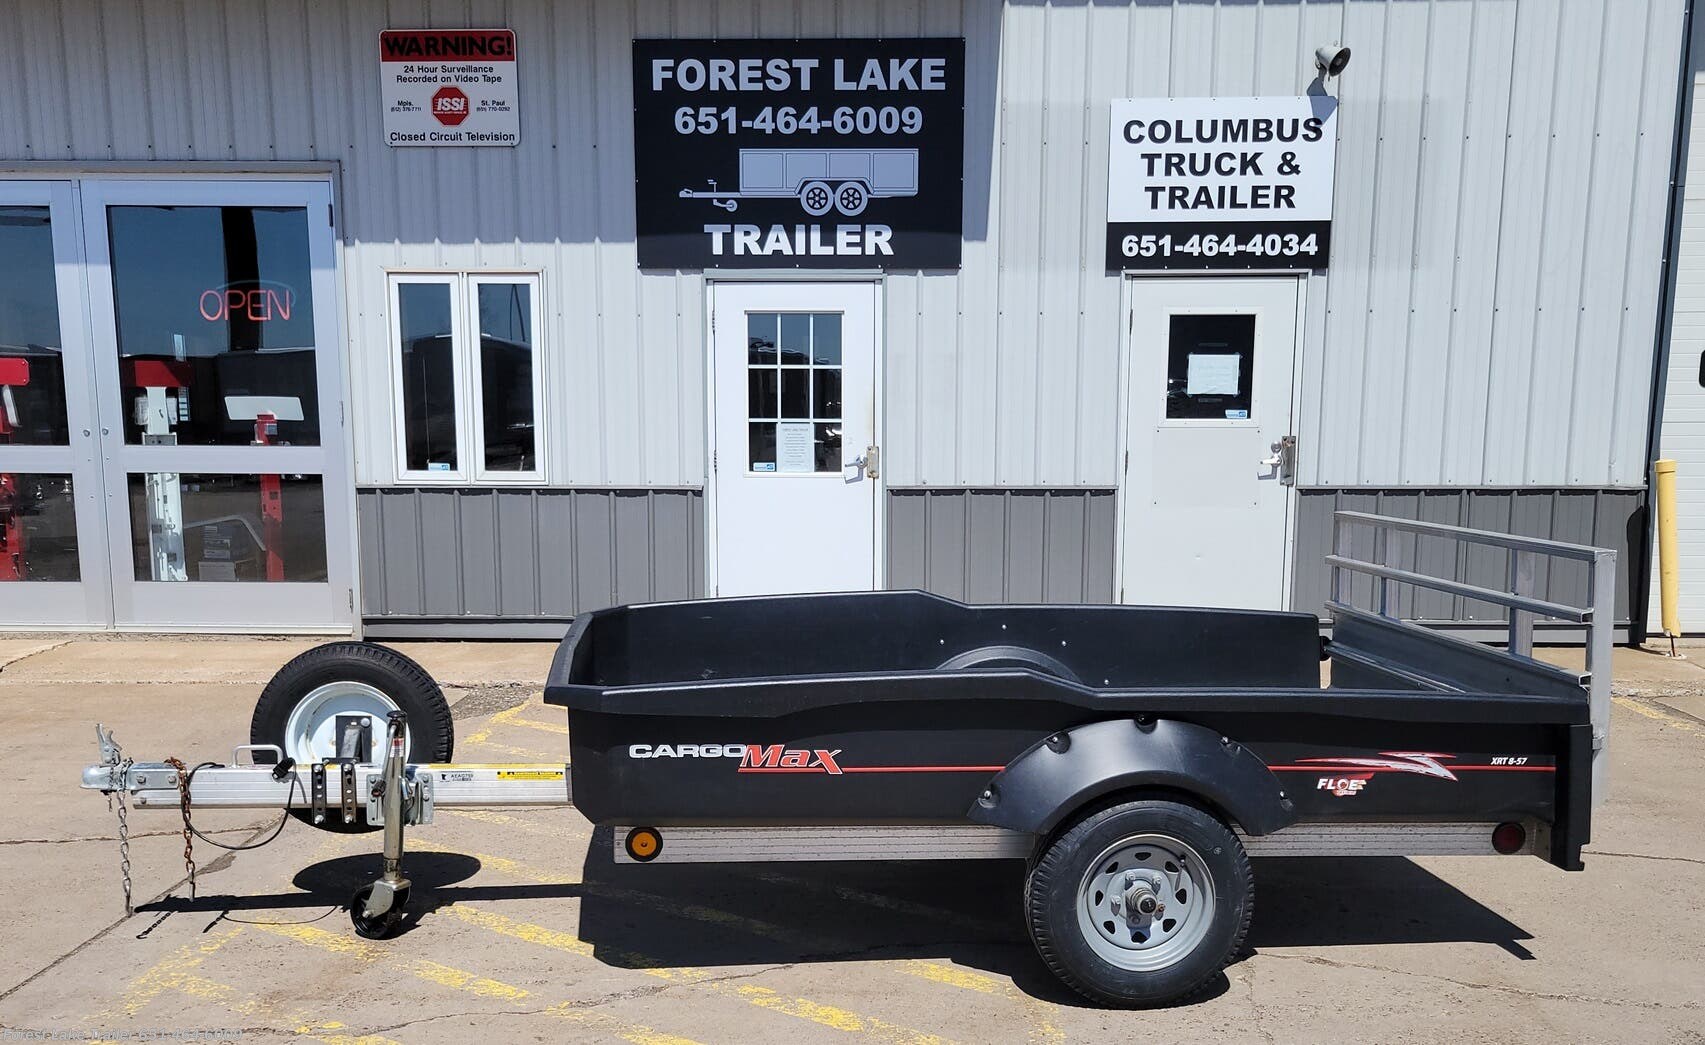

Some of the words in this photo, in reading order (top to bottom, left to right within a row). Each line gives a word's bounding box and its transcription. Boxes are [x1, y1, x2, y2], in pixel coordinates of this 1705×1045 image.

[384, 36, 512, 56] WARNING!
[396, 75, 438, 83] Recorded
[454, 75, 479, 83] Video
[482, 75, 502, 84] Tape
[417, 65, 438, 73] Hour
[441, 65, 494, 73] Surveillance
[652, 59, 819, 91] FOREST
[833, 58, 946, 91] LAKE
[437, 97, 465, 111] ISSI
[674, 106, 923, 134] 651-464-6009
[1123, 117, 1323, 144] COLUMBUS
[390, 132, 425, 141] Closed
[429, 132, 462, 141] Circuit
[465, 132, 515, 141] Television
[1140, 152, 1264, 177] TRUCK
[1276, 151, 1301, 176] &
[1144, 185, 1296, 210] TRAILER
[703, 224, 894, 256] TRAILER
[1121, 233, 1318, 257] 651-464-4034
[199, 290, 291, 321] OPEN
[1508, 757, 1528, 765] 8-57
[1316, 778, 1367, 790] FLOE
